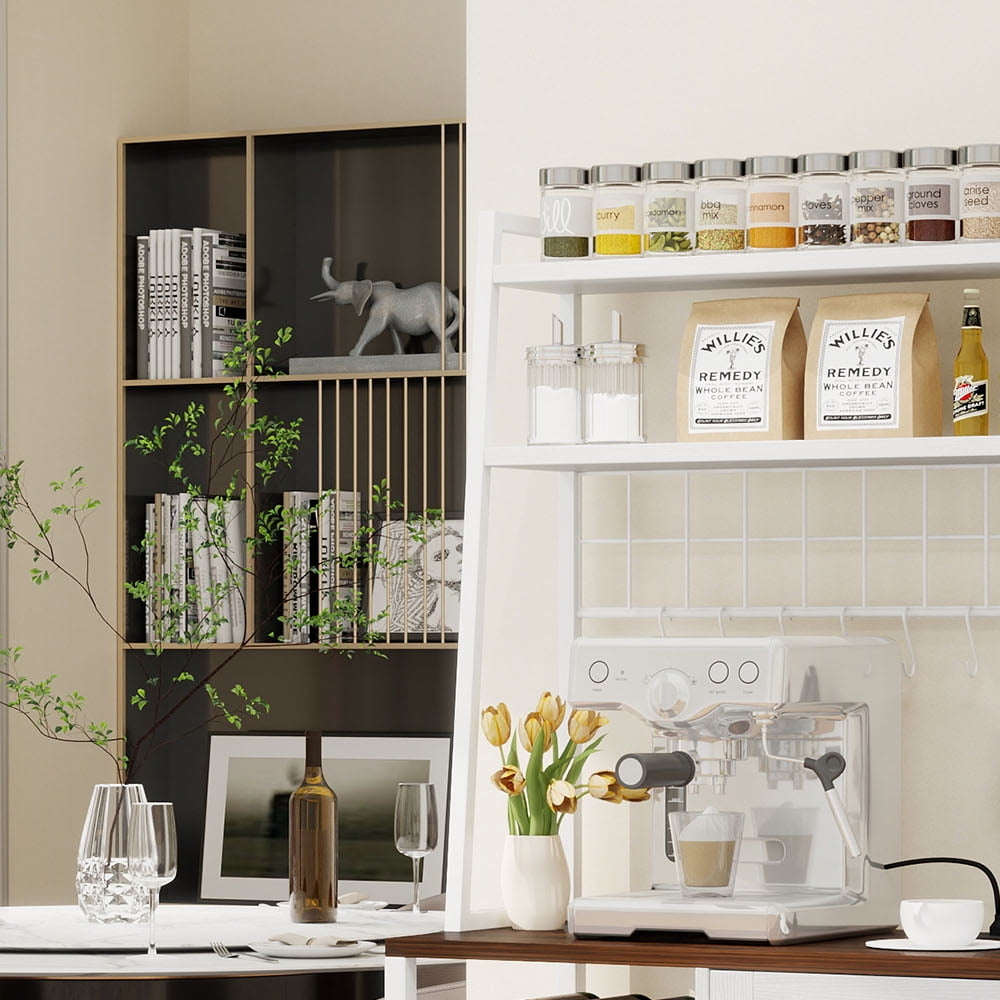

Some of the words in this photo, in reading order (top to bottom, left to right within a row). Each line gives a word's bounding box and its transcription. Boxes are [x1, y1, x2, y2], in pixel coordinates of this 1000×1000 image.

[908, 188, 942, 202] ground
[963, 184, 990, 195] anise
[964, 195, 989, 206] seed
[596, 211, 620, 222] curry
[702, 210, 719, 220] mix
[701, 332, 766, 354] WILLIE'S
[829, 328, 896, 350] WILLIE'S
[700, 371, 761, 382] REMEDY
[828, 368, 891, 378] REMEDY
[735, 384, 763, 392] BEAN
[824, 382, 860, 390] WHOLE
[864, 380, 894, 388] BEAN
